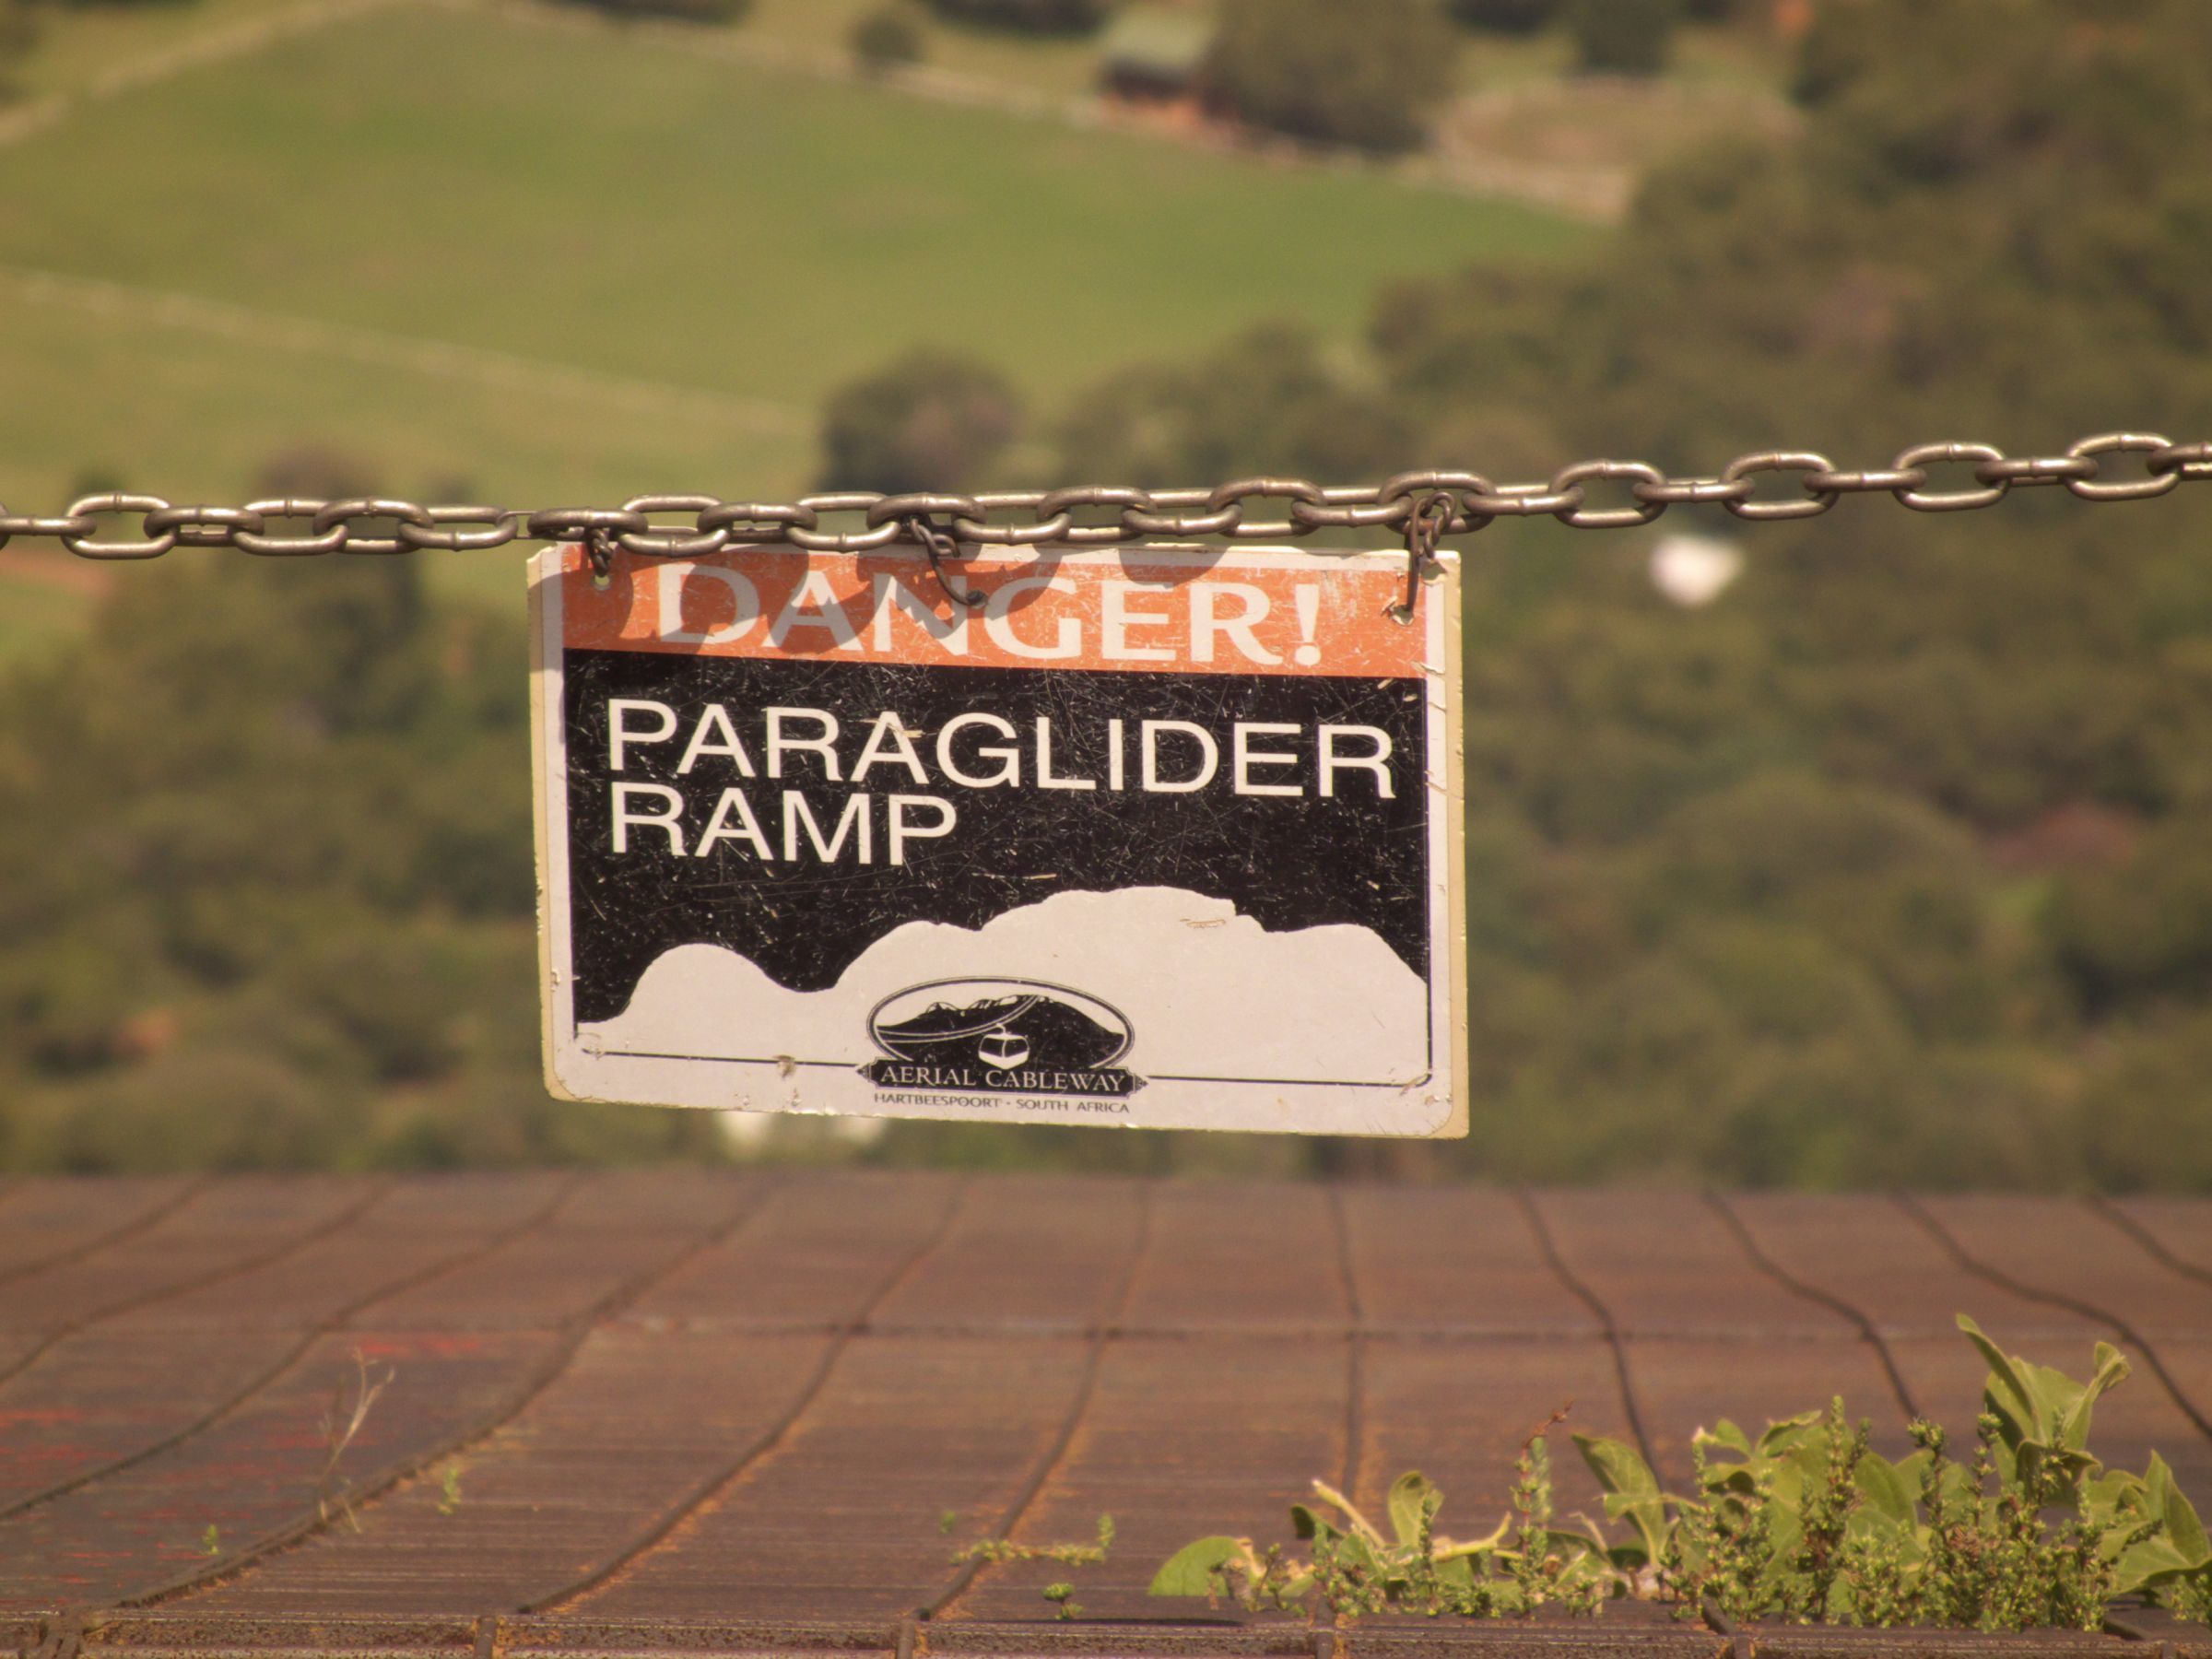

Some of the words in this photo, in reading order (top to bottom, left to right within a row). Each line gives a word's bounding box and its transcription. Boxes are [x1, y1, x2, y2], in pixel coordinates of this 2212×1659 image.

[658, 561, 1322, 666] DANGER!
[607, 698, 1396, 799] PARAGLIDER
[611, 782, 958, 866] RAMP
[873, 1092, 1002, 1108] HARTBEESPOORT
[1016, 1098, 1069, 1112] SOUTH
[1076, 1100, 1130, 1113] AFRICA
[879, 1065, 977, 1088] AERIAL
[984, 1069, 1126, 1093] CABLEWAY
